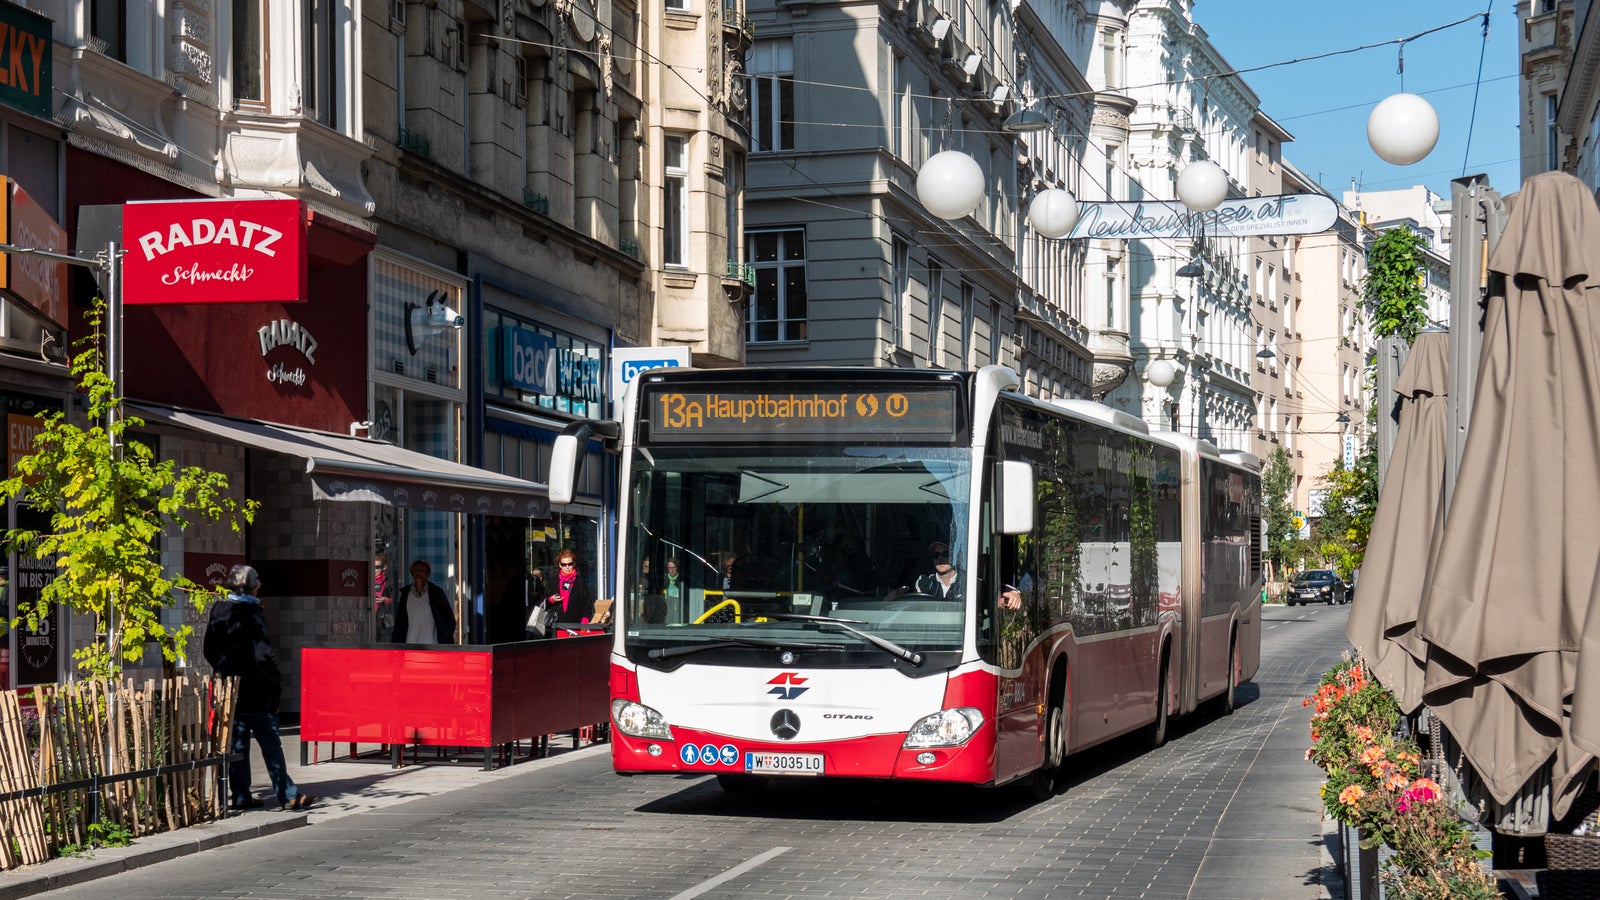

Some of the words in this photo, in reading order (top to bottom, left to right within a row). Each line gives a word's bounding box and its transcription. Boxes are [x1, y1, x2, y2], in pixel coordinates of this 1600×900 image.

[138, 218, 283, 262] RADATZ
[257, 319, 318, 365] RADATZ
[660, 393, 703, 428] 13A
[706, 393, 848, 423] Hauptbahnhof
[19, 572, 28, 588] IN
[30, 573, 43, 588] BIS
[25, 636, 50, 646] MINUTEN
[822, 713, 874, 721] CITARO
[755, 755, 764, 768] W
[773, 756, 803, 769] 3035
